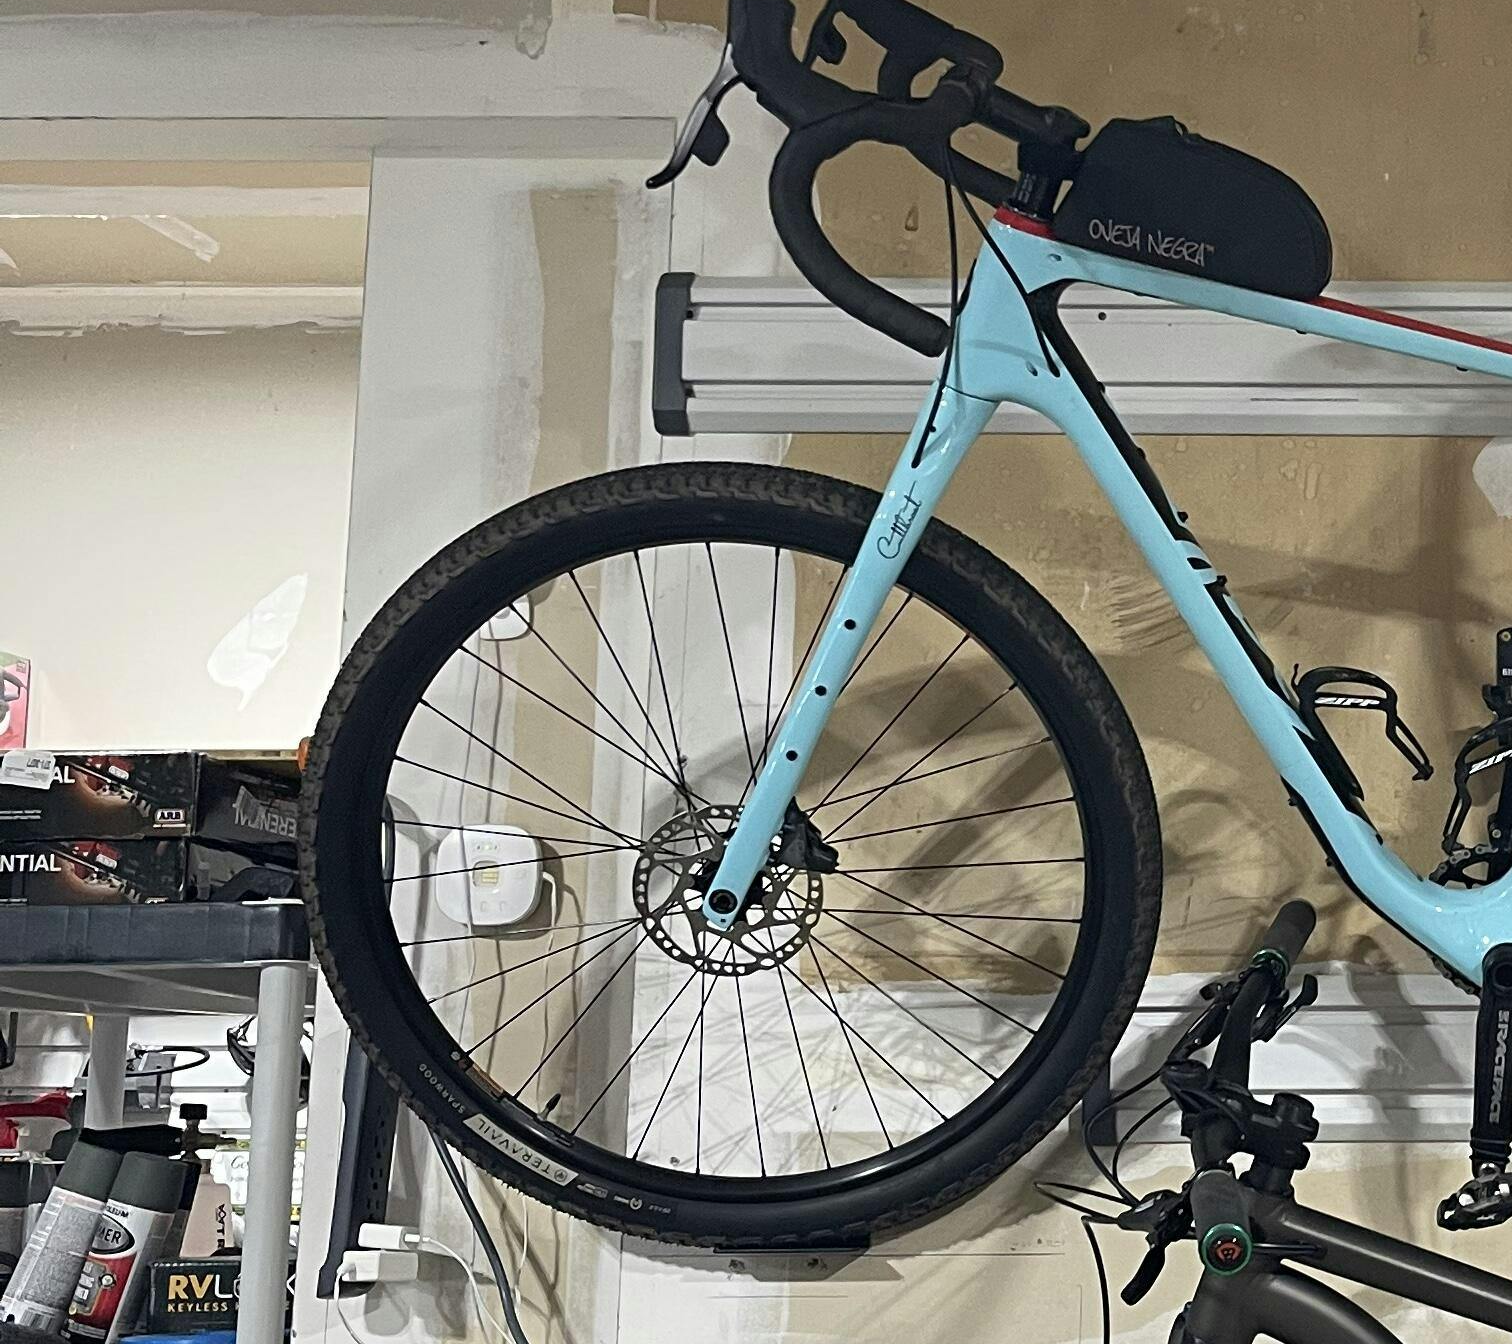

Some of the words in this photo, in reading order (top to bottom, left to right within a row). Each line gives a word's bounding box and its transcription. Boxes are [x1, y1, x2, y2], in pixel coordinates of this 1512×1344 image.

[1089, 219, 1140, 252] OVEJA
[1314, 697, 1380, 706] ZIPP
[418, 1063, 465, 1114] SPARWOOD
[478, 1117, 550, 1174] TERAVAIL
[167, 1302, 228, 1312] KEYLESS
